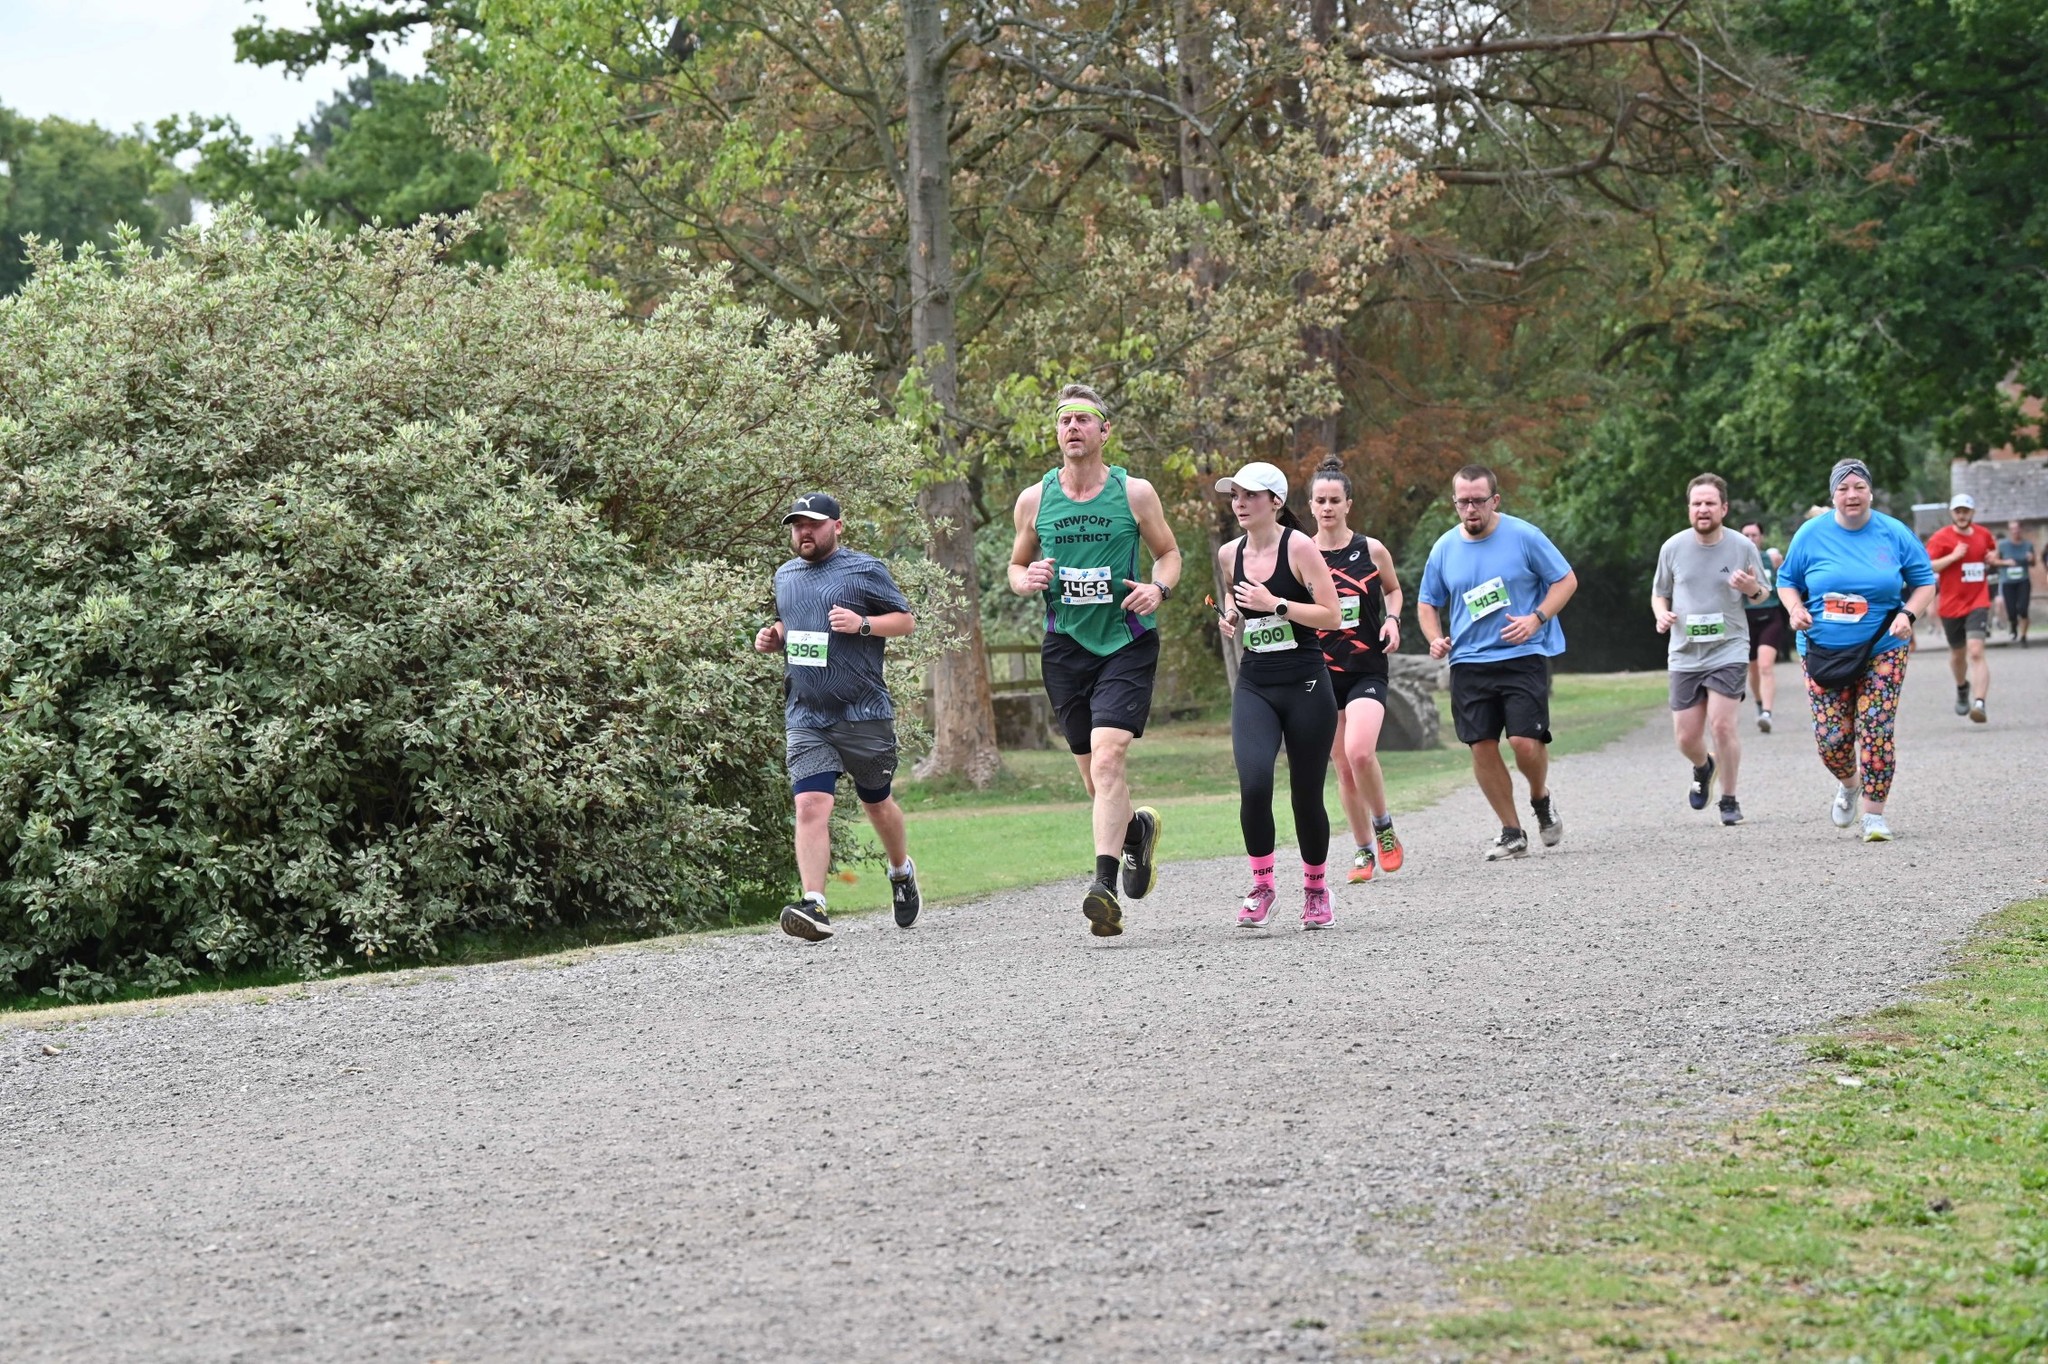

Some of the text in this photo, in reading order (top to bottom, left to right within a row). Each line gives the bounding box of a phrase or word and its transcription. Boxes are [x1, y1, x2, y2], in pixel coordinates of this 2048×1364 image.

[1054, 515, 1113, 531] NEWPORT
[1055, 533, 1111, 544] DISTRICT
[1063, 581, 1109, 597] 1468
[1474, 591, 1500, 608] 413
[1341, 608, 1353, 621] 2
[1836, 600, 1856, 615] 46
[1250, 627, 1285, 647] 600
[1691, 624, 1718, 636] 636
[791, 643, 819, 658] 396
